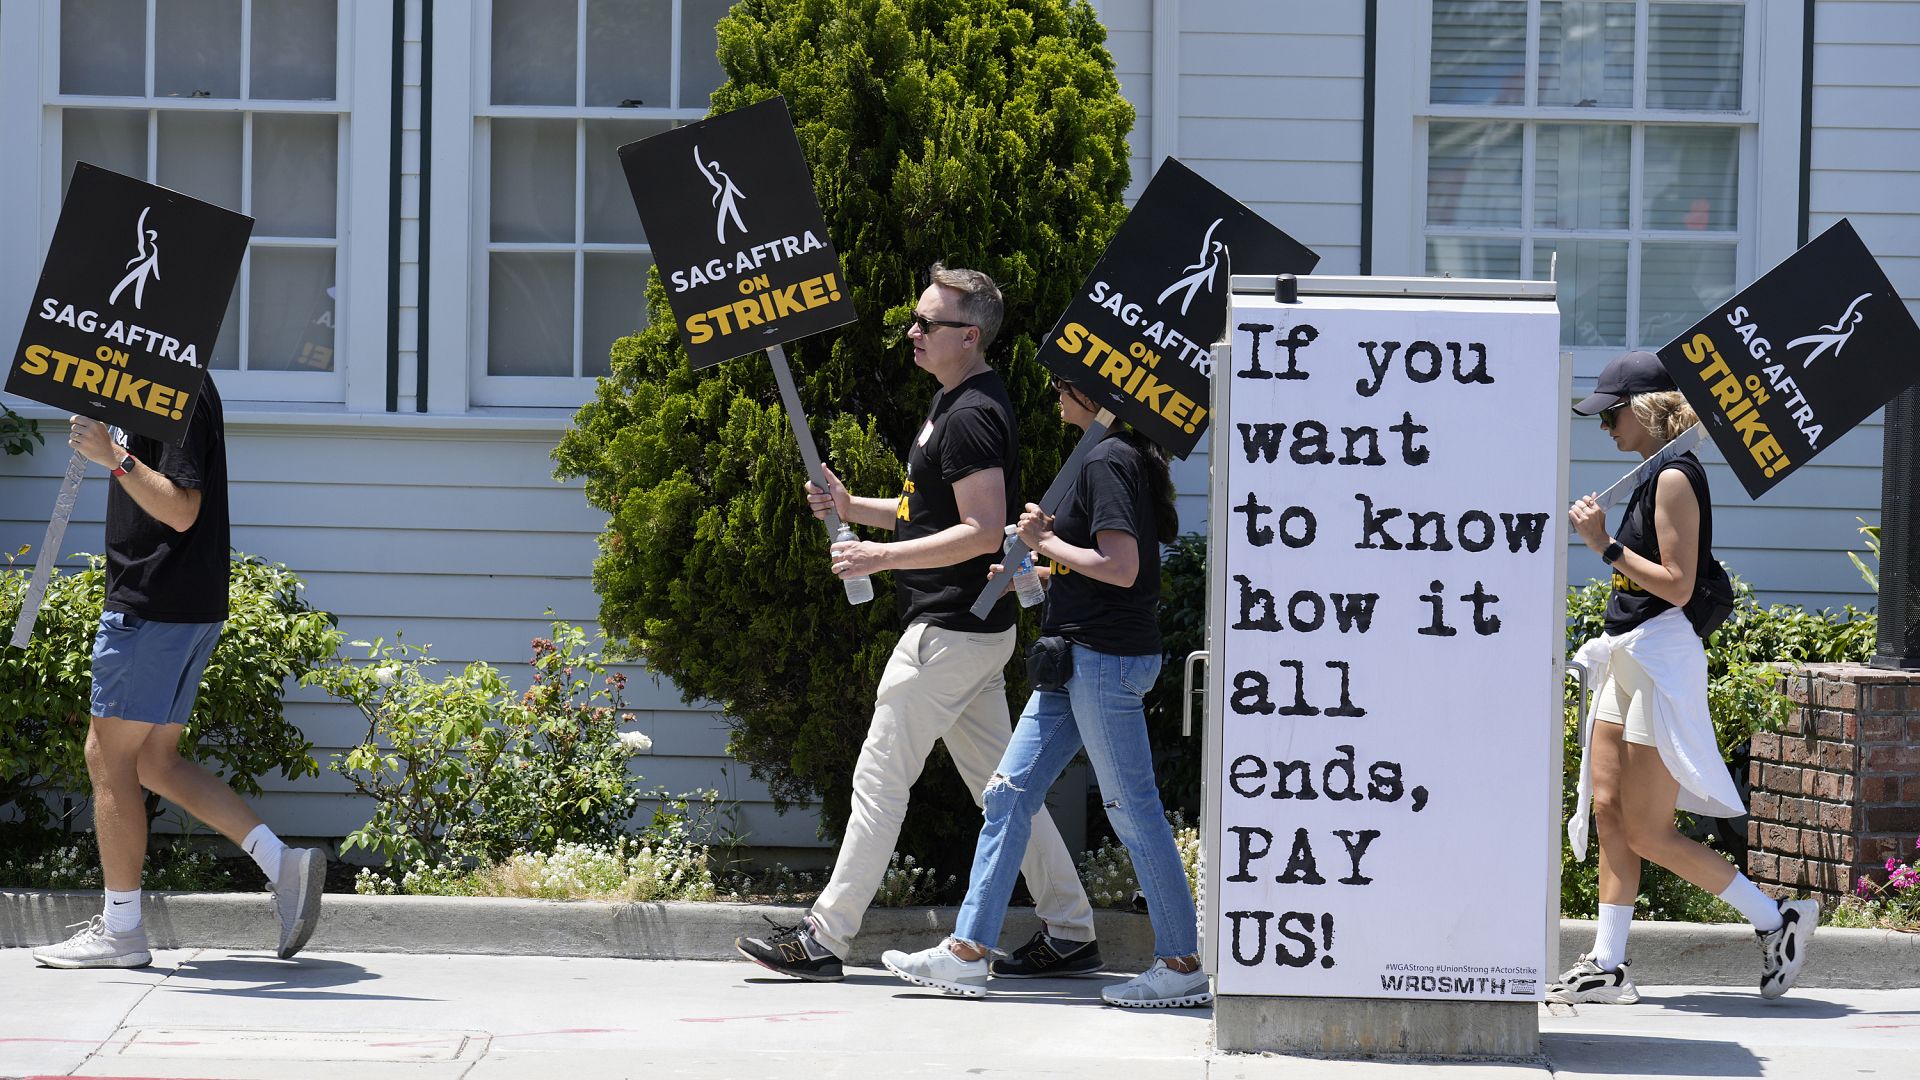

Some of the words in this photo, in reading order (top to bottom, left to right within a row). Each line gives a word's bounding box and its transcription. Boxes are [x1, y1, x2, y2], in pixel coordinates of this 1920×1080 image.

[685, 272, 842, 345] STRIKE!
[738, 273, 770, 295] ON
[20, 344, 189, 421] STRIKE!
[95, 345, 129, 368] ON
[1056, 322, 1207, 434] STRIKE!
[1129, 341, 1161, 369] ON
[1236, 322, 1320, 381] If
[1355, 340, 1495, 398] you
[1681, 333, 1791, 479] STRIKE!
[1744, 374, 1770, 406] ON
[1236, 410, 1431, 467] want
[1233, 491, 1318, 549] to
[1354, 492, 1551, 554] know
[1231, 574, 1381, 634] how
[1417, 579, 1502, 637] it
[1229, 659, 1368, 718] all
[1229, 744, 1429, 813] ends,
[1226, 825, 1381, 886] PAY
[1224, 910, 1338, 969] US!
[1385, 963, 1434, 973] #WGAStrong
[1436, 964, 1489, 974] #UnionStrong
[1490, 966, 1537, 975] #ActorStrike
[1380, 974, 1506, 995] WRDSMTH
